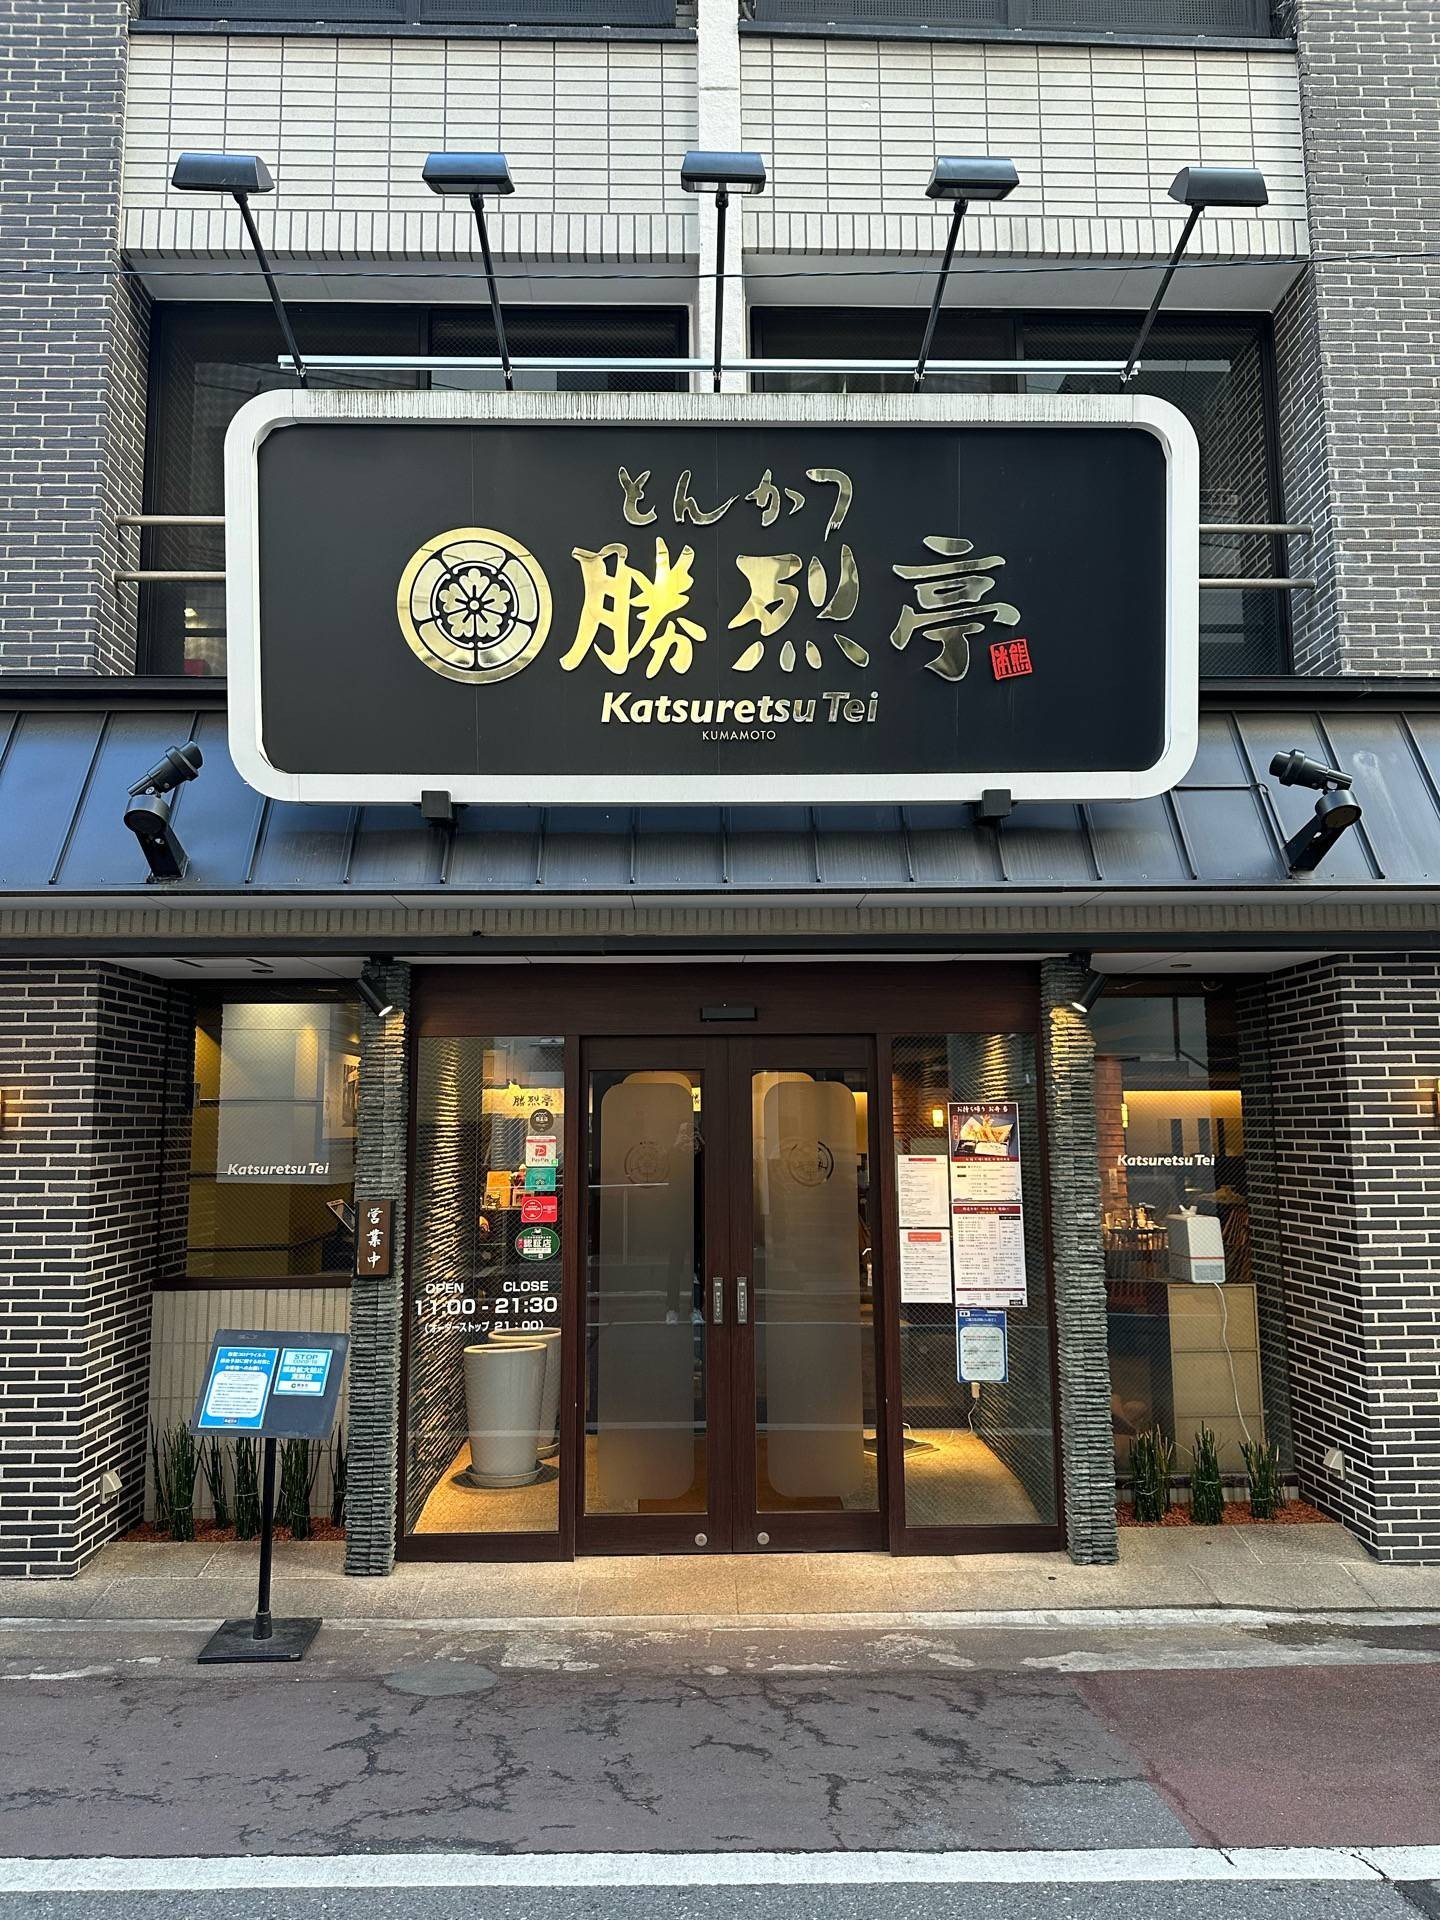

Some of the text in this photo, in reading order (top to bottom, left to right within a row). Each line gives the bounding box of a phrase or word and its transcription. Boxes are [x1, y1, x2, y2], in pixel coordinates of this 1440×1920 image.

[618, 466, 854, 542] とんかつ
[559, 536, 1021, 681] 勝烈亭
[601, 691, 879, 724] Katsuretsu Tei
[702, 730, 776, 741] KUMAMOTO
[227, 1162, 330, 1176] Katsuretsu Tei
[1117, 1154, 1216, 1167] Katsuretsu Tei
[366, 1207, 385, 1269] 営業中
[425, 1280, 549, 1294] OPEN CLOSE
[415, 1299, 476, 1316] 11:00
[494, 1296, 558, 1314] 21:30
